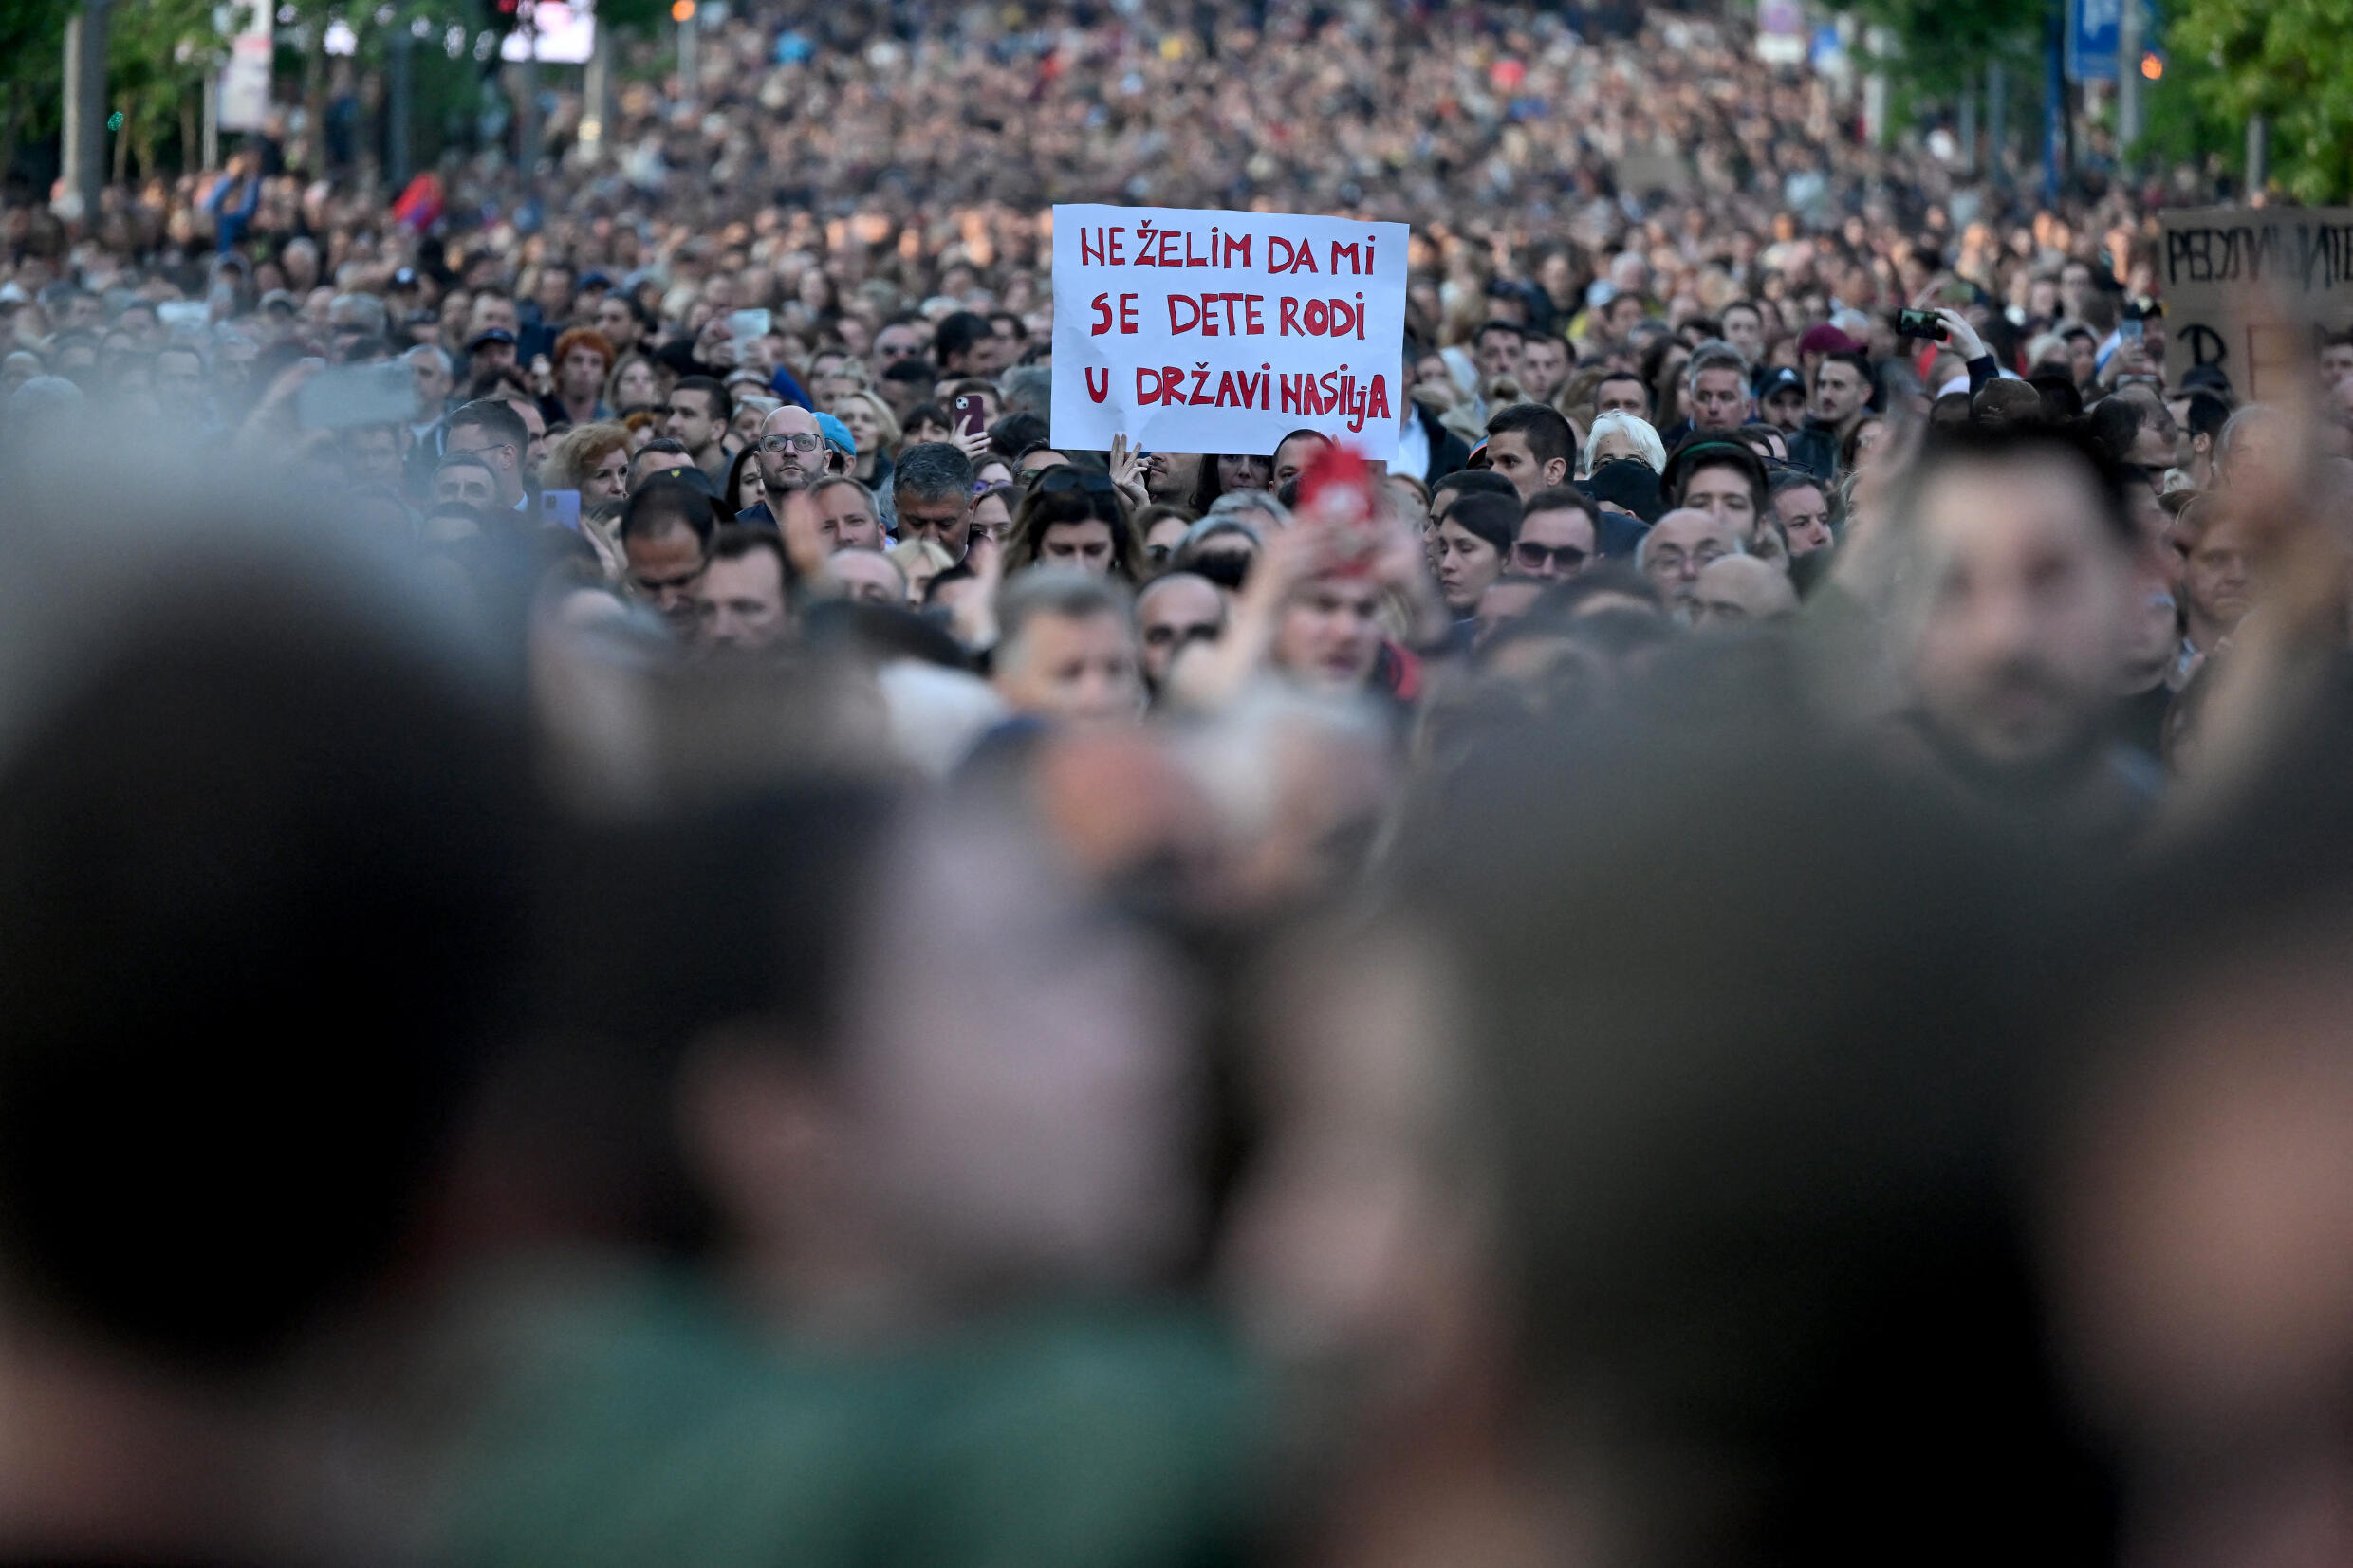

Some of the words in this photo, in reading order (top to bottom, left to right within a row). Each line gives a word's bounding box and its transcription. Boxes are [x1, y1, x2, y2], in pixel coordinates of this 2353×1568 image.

[1081, 227, 1126, 267] NE
[1268, 235, 1319, 274] DA
[1091, 292, 1139, 337] SE
[1167, 292, 1265, 337] DETE
[1084, 367, 1109, 404] U
